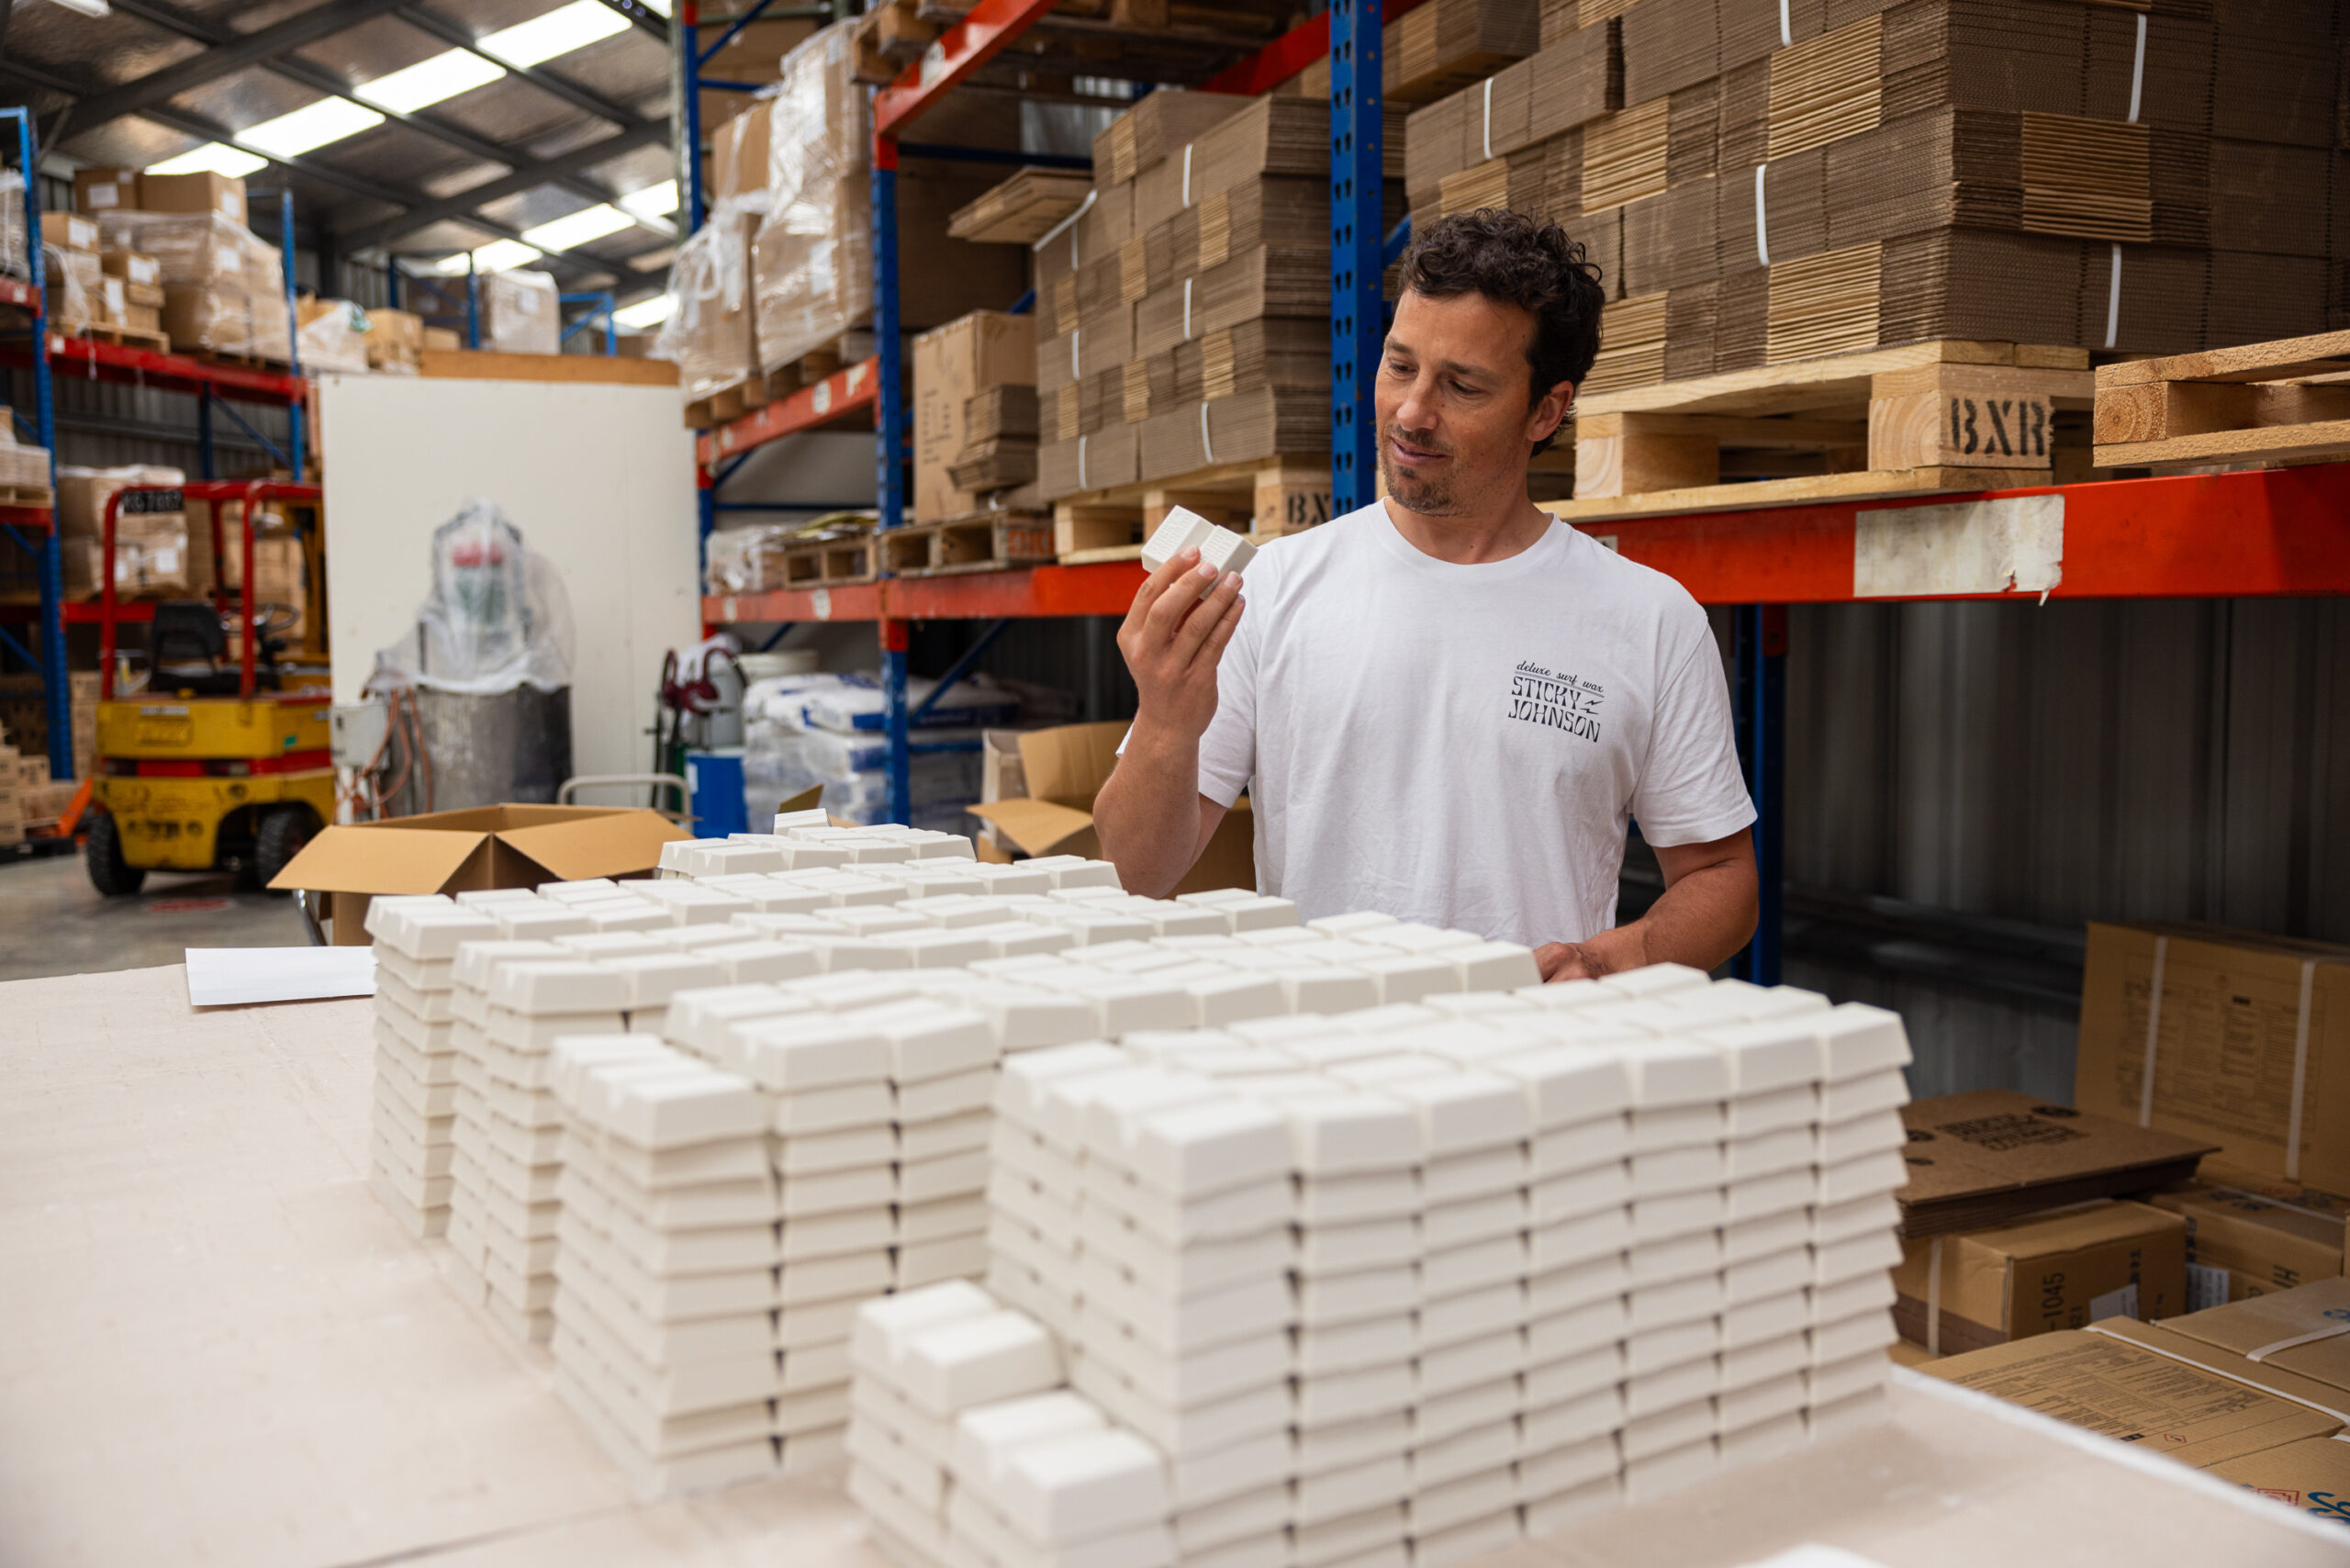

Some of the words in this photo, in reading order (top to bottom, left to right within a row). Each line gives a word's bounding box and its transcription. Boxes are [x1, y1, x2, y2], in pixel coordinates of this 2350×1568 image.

[1951, 397, 2046, 457] BXR
[1511, 675, 1582, 711] STICKY
[1516, 660, 1551, 677] deluxe
[1556, 672, 1578, 686] surf
[1582, 680, 1605, 693] wax
[1507, 699, 1602, 744] JOHNSON
